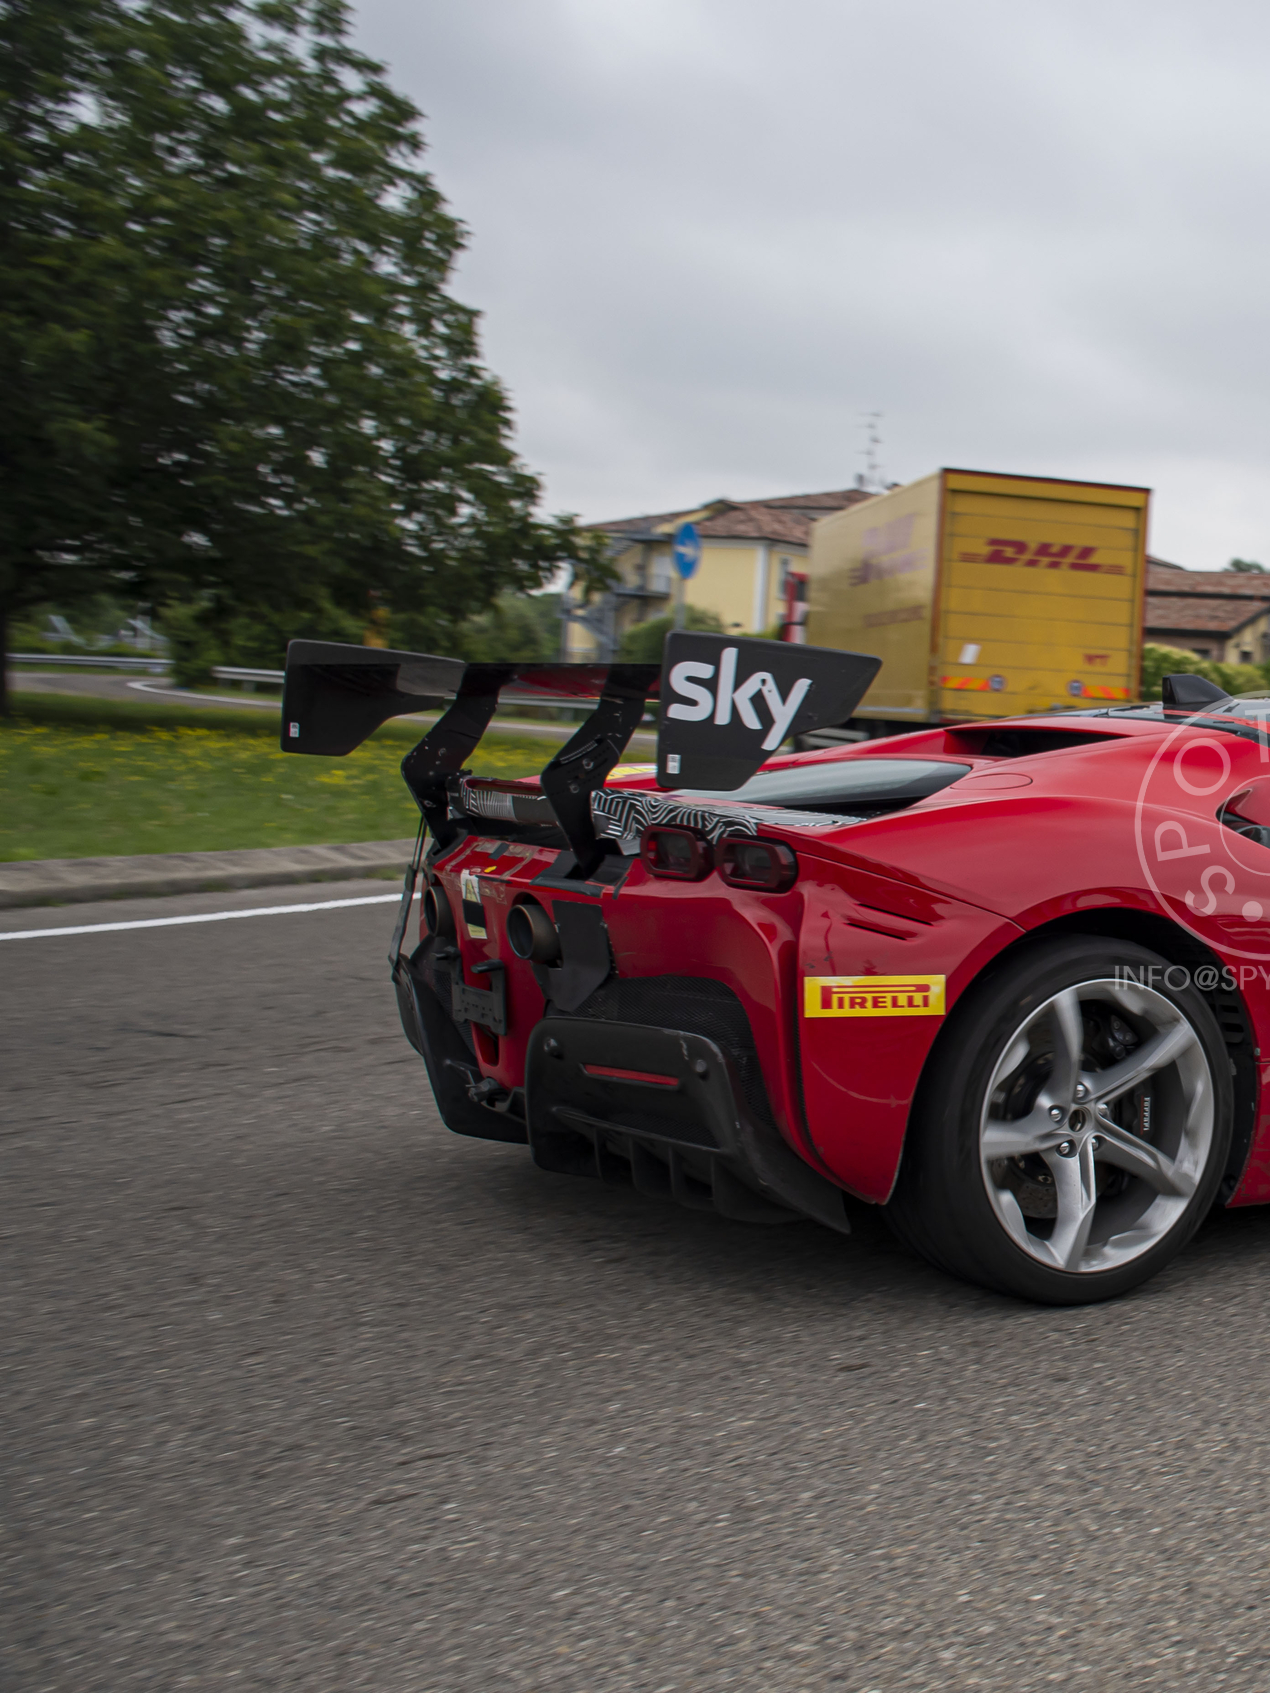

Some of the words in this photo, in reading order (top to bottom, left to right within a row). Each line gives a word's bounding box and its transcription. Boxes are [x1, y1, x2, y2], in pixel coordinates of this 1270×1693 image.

[984, 538, 1100, 571] DHL
[666, 647, 813, 751] sky
[820, 984, 931, 1010] PIRELLI
